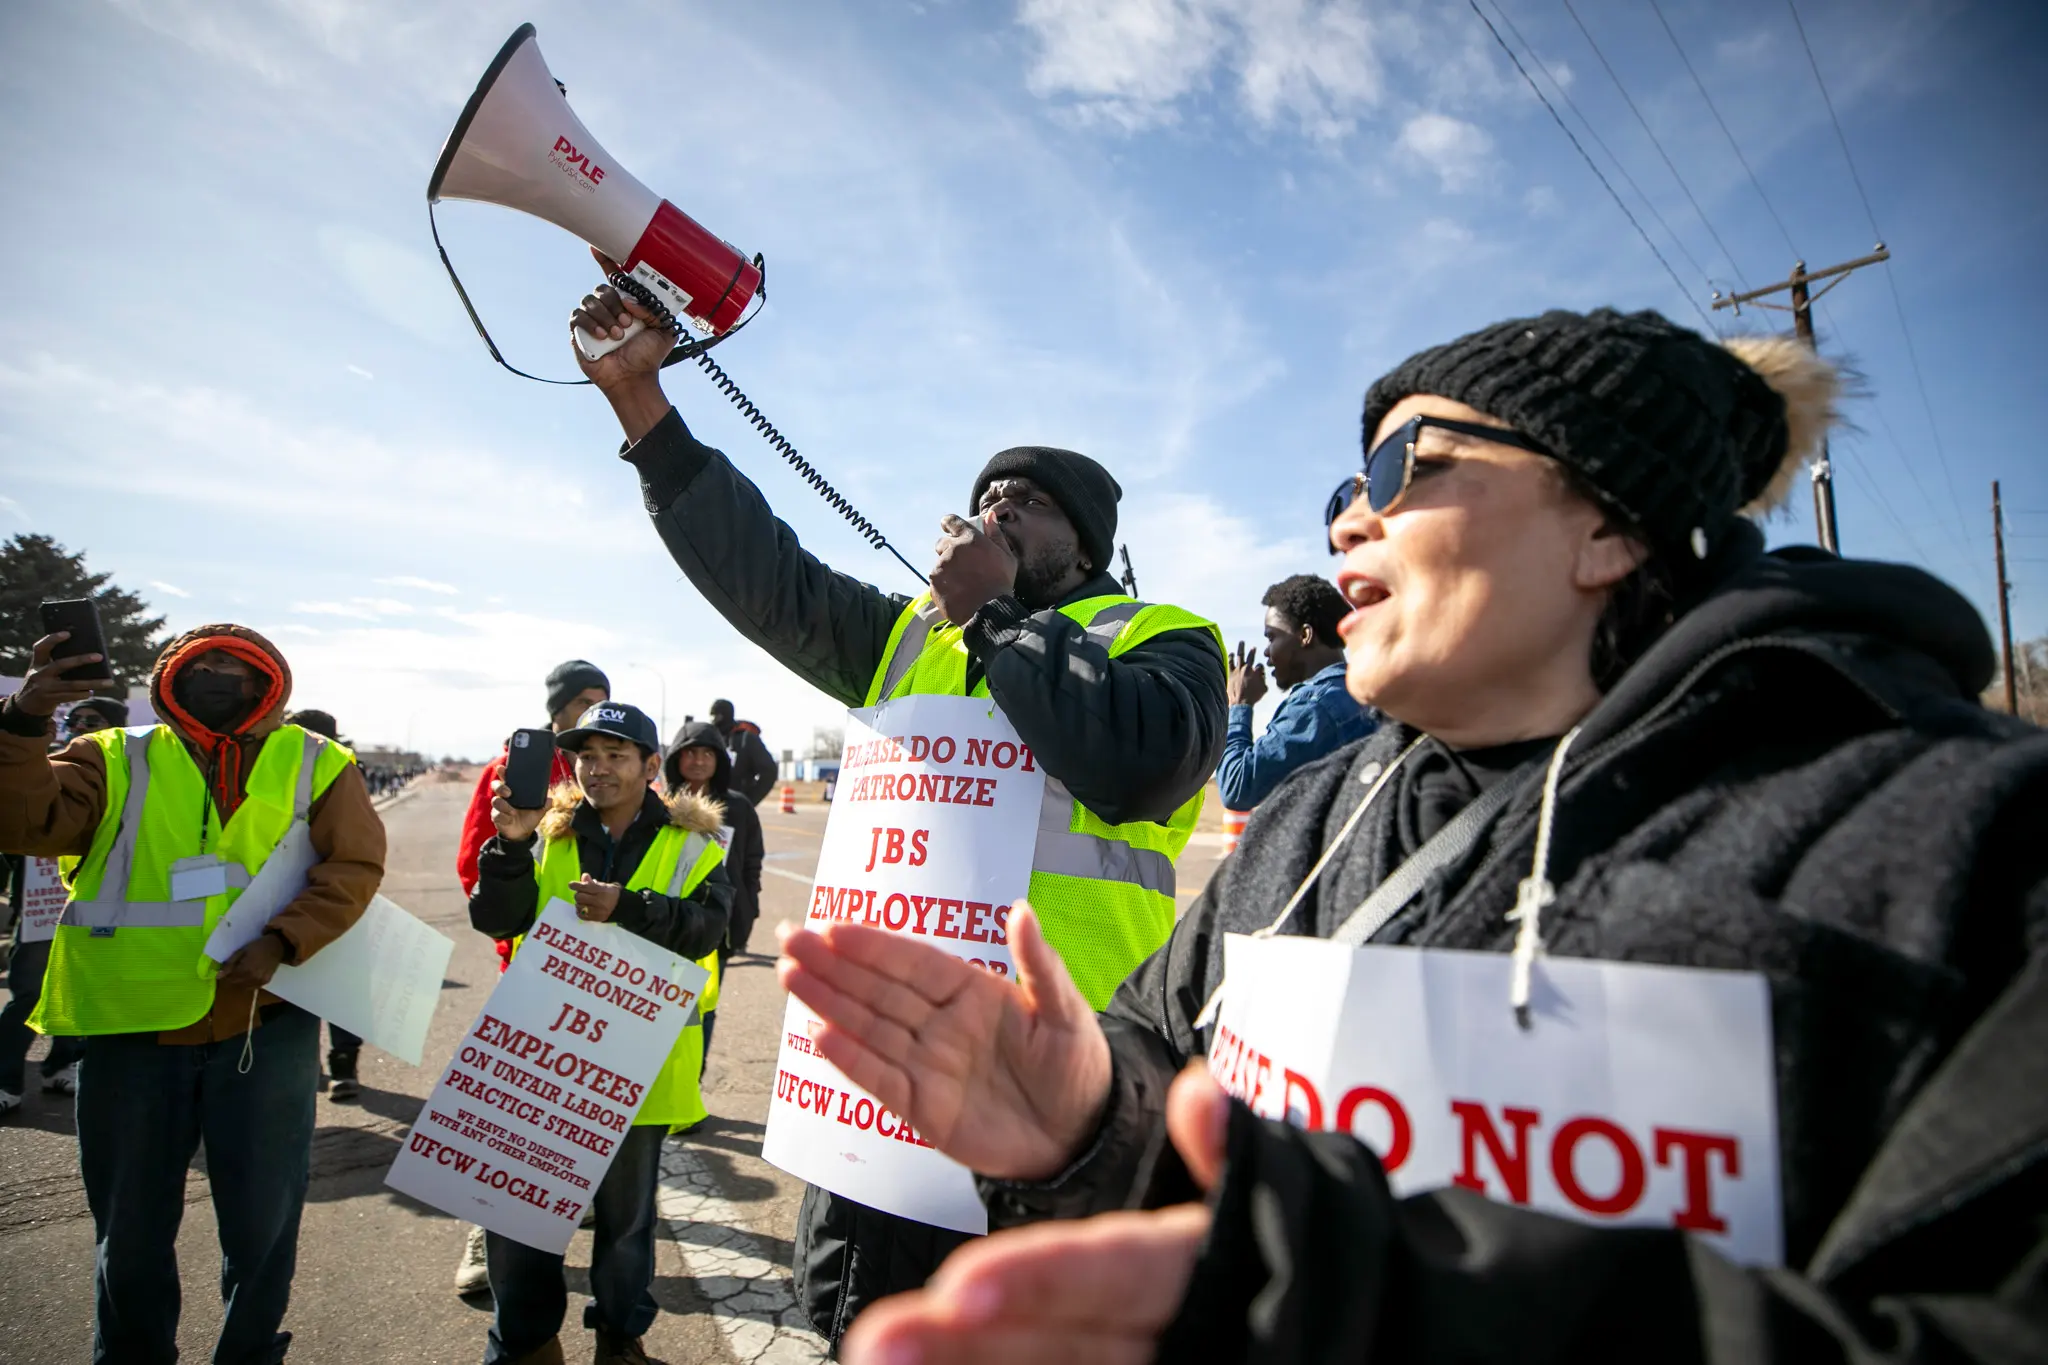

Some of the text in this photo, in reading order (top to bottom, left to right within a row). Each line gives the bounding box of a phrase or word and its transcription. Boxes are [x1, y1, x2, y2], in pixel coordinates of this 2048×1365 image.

[547, 150, 596, 193] PyleUSA.com
[553, 135, 605, 185] PYLE
[907, 735, 955, 763] DO
[963, 738, 1034, 771] NOT
[850, 773, 997, 807] PATRONIZE
[865, 827, 928, 872] JBS
[810, 886, 1012, 946] EMPLOYEES
[533, 922, 695, 1009] PLEASE DO NOT
[541, 954, 662, 1023] PATRONIZE
[547, 1002, 608, 1043] JBS
[787, 1032, 812, 1055] WITH
[459, 1046, 627, 1133] ON UNFAIR LABOR
[473, 1014, 644, 1108] EMPLOYEES
[444, 1068, 614, 1157] PRACTICE STRIKE
[777, 1069, 834, 1116] UFCW
[430, 1110, 590, 1189] WITH ANY OTHER EMPLOYER
[456, 1107, 576, 1170] WE HAVE NO DISPUTE
[1284, 1067, 1413, 1173] DO
[1450, 1099, 1742, 1234] NOT
[408, 1131, 583, 1221] UFCW LOCAL #7
